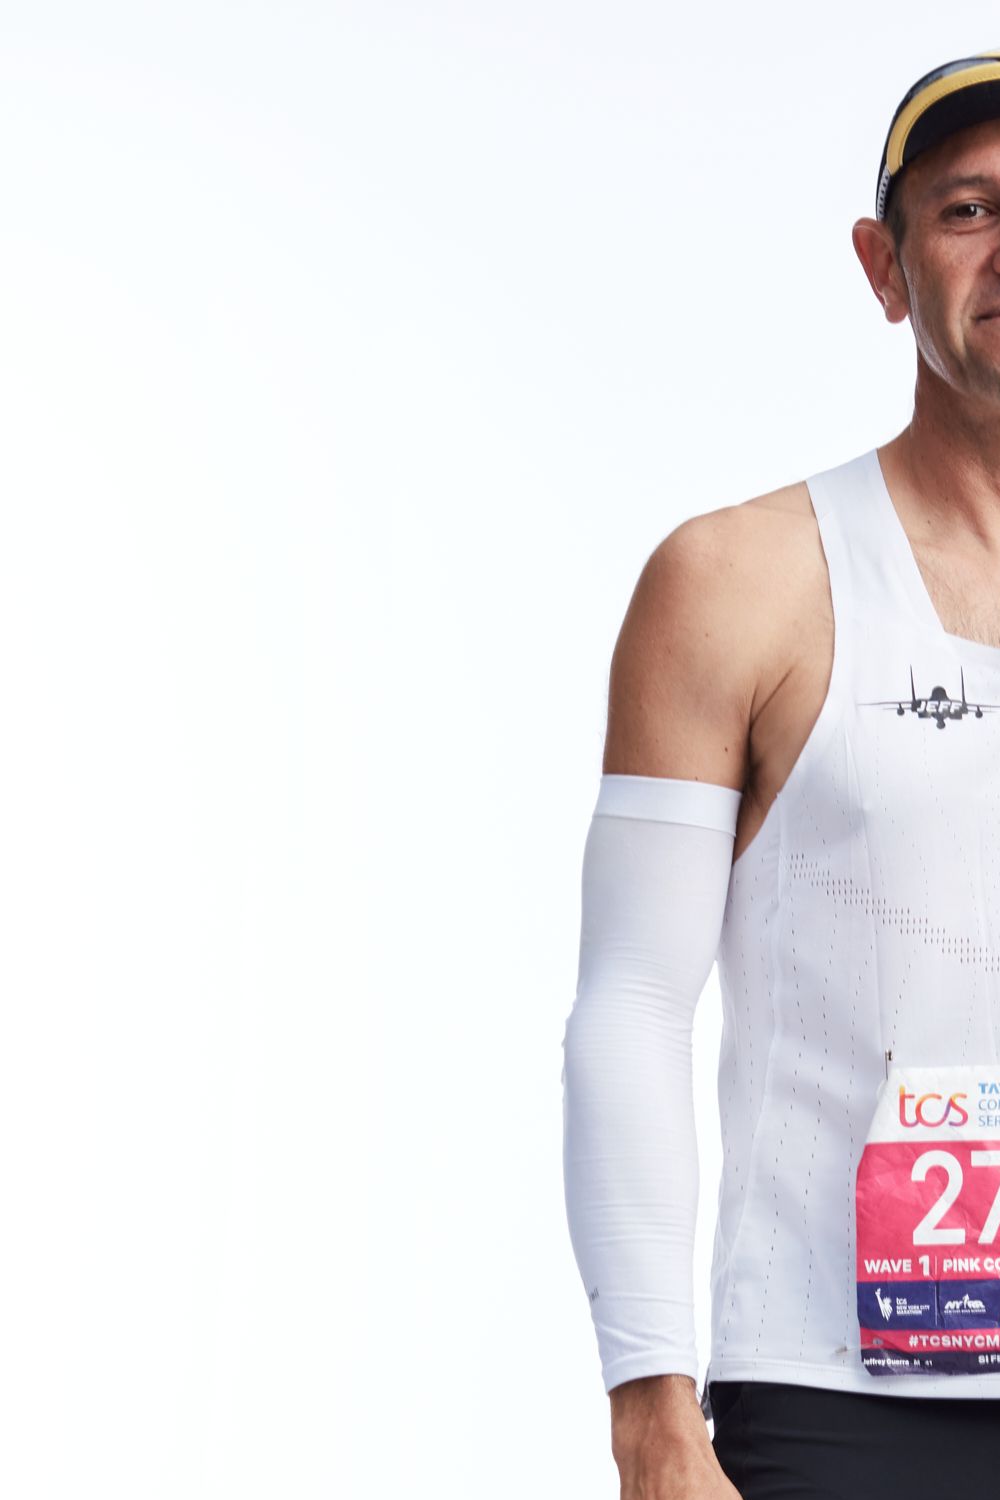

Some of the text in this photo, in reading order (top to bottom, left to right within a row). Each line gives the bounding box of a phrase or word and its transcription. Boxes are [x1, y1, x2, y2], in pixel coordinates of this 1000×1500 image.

[917, 701, 961, 713] JEFF
[899, 1085, 969, 1128] tcs
[864, 1255, 930, 1276] WAVE 1
[943, 1257, 980, 1273] PINK
[863, 1358, 885, 1367] Jeffrey
